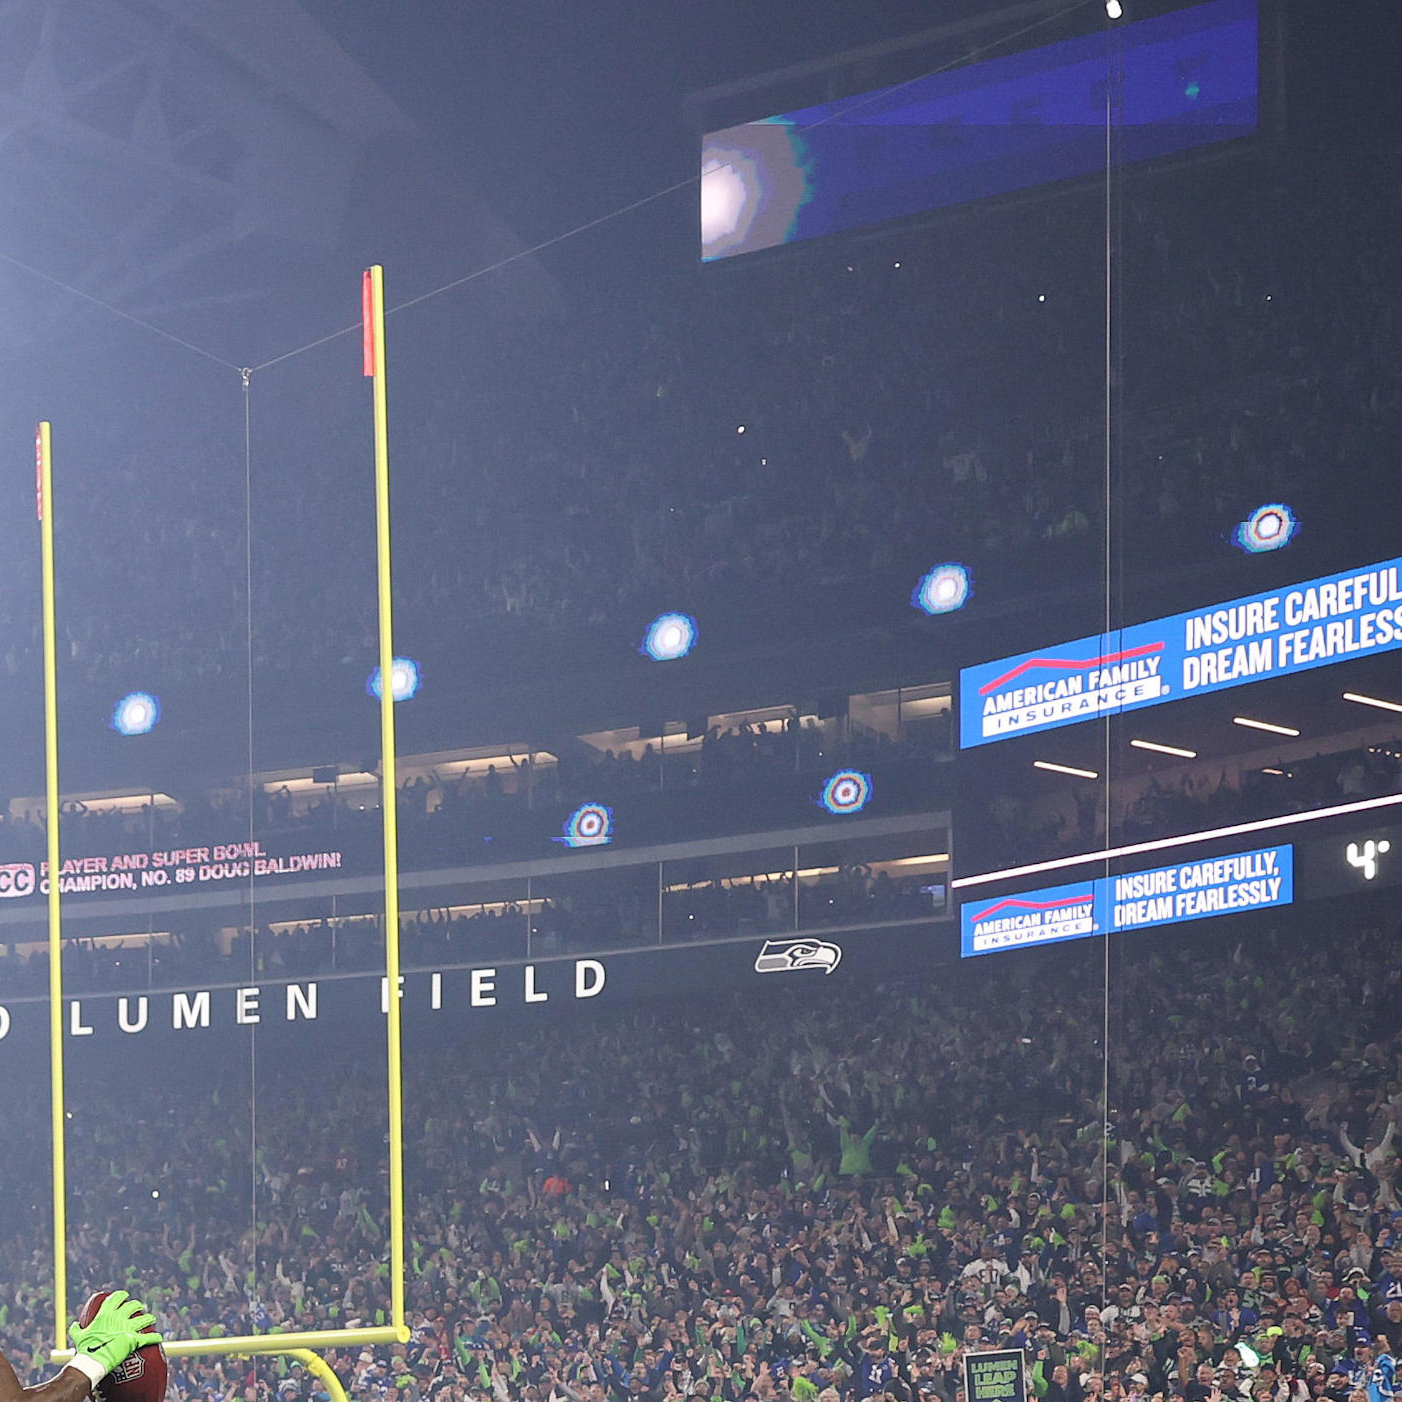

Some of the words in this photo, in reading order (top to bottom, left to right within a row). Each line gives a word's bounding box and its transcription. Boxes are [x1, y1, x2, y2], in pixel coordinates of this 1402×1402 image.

[1185, 598, 1280, 652] INSURE
[1284, 567, 1402, 626] CAREFUL
[1182, 638, 1272, 690] DREAM
[983, 669, 1083, 716] AMERICAN
[1088, 655, 1162, 691] FAMILY
[997, 683, 1146, 729] INSURANCE
[41, 857, 107, 877] PAYER
[110, 853, 148, 871] AND
[152, 847, 209, 867] SUPER
[141, 869, 172, 886] NO.
[175, 868, 195, 883] 89
[199, 862, 250, 881] DOUG
[254, 853, 342, 876] BALDWIN!
[1115, 865, 1177, 901] INSURE
[1179, 851, 1280, 890] CAREFULLY,
[974, 912, 1043, 937] AMERICAN
[1044, 904, 1094, 925] FAMILY
[1114, 896, 1173, 927] DREAM
[1176, 877, 1282, 917] FEARLESSLY
[983, 922, 1083, 946] INSURANCE
[70, 982, 317, 1036] LUMEN
[380, 959, 607, 1014] FIELD
[971, 1360, 1018, 1374] LUMEN
[974, 1371, 1017, 1386] LEAP
[975, 1384, 1016, 1399] HERE
